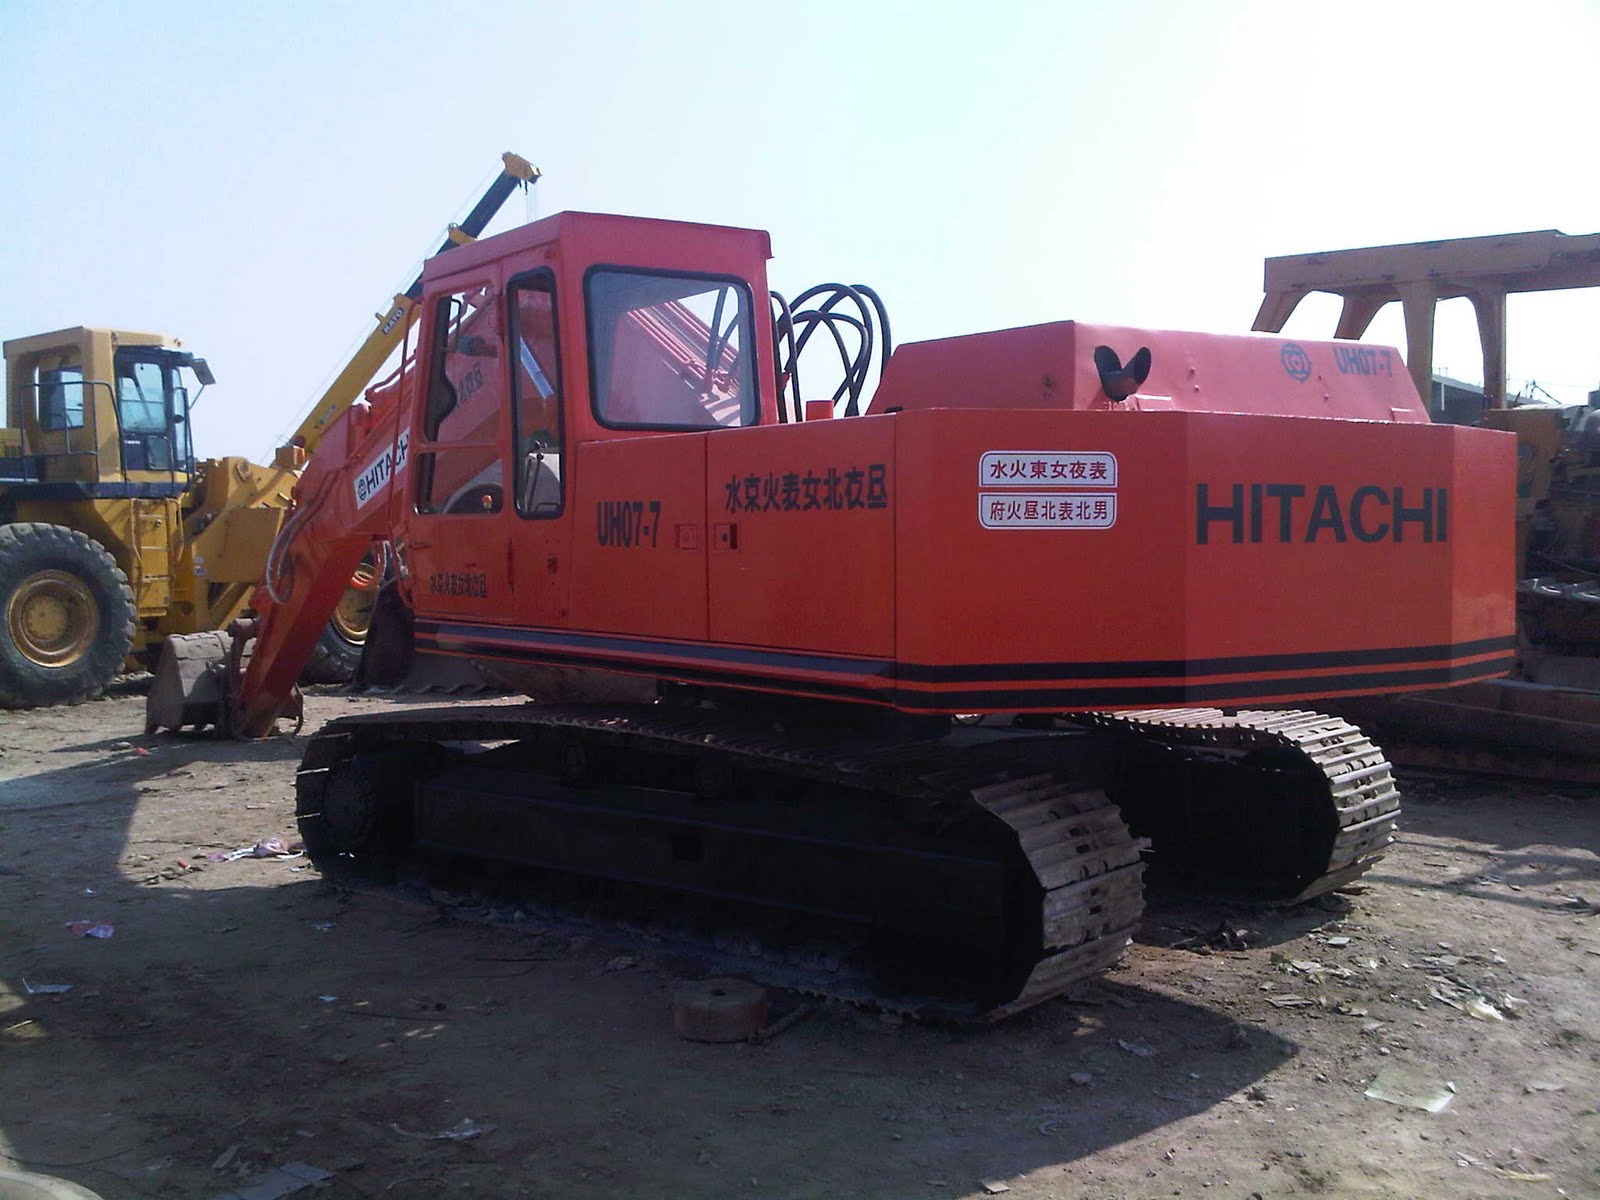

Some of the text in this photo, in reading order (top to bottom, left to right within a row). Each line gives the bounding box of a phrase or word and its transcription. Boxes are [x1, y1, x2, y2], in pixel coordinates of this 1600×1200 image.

[1332, 346, 1392, 377] UH07-7
[990, 460, 1107, 480] 水火東女夜表
[596, 500, 661, 548] UH07-7
[990, 500, 1107, 521] 府火昼北表北男
[1196, 483, 1448, 545] HITACHI
